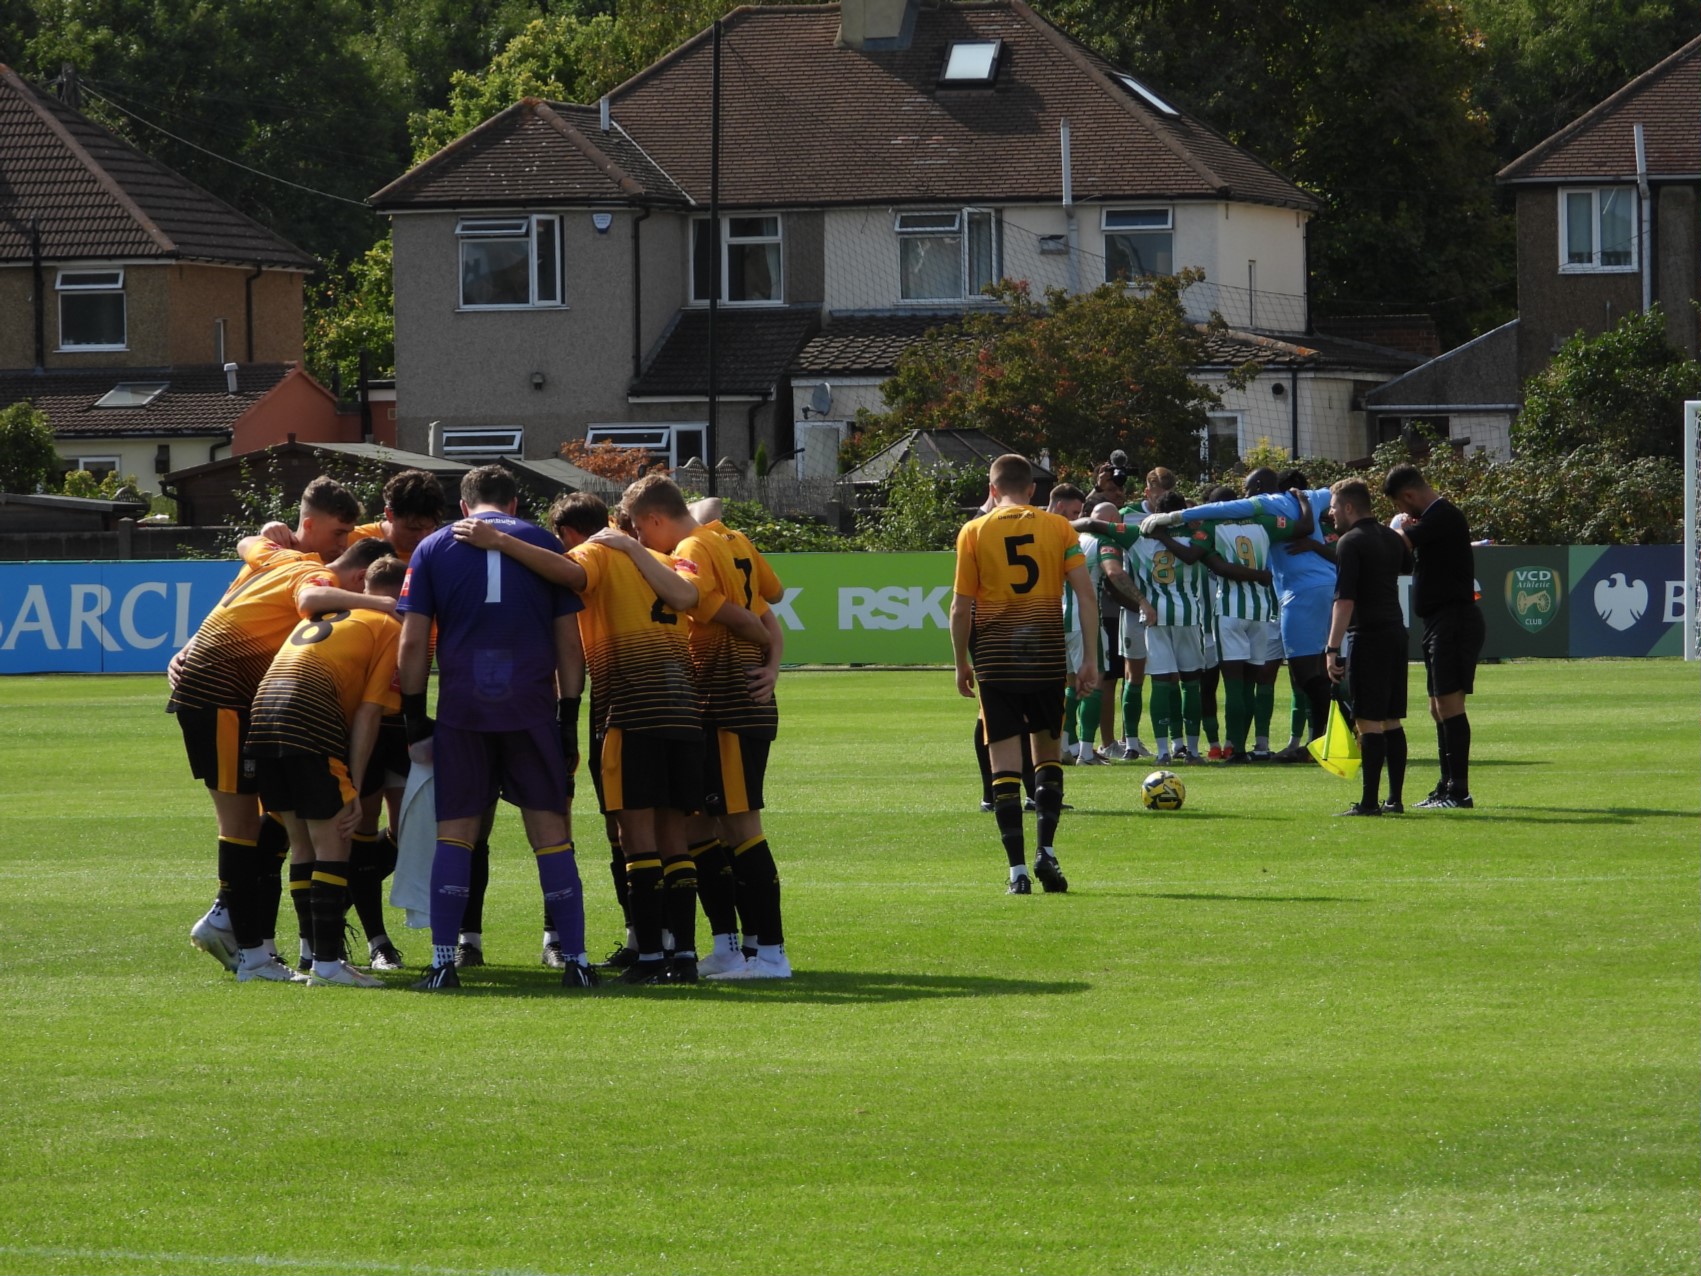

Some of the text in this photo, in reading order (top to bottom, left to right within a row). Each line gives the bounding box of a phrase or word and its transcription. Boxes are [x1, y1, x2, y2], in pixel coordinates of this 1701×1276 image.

[1003, 533, 1040, 595] 5
[1151, 550, 1176, 585] 8
[1515, 570, 1552, 581] VCD
[1516, 580, 1551, 589] Athletic
[838, 586, 952, 631] RSK
[1524, 617, 1543, 626] CLUB
[289, 608, 351, 647] 8
